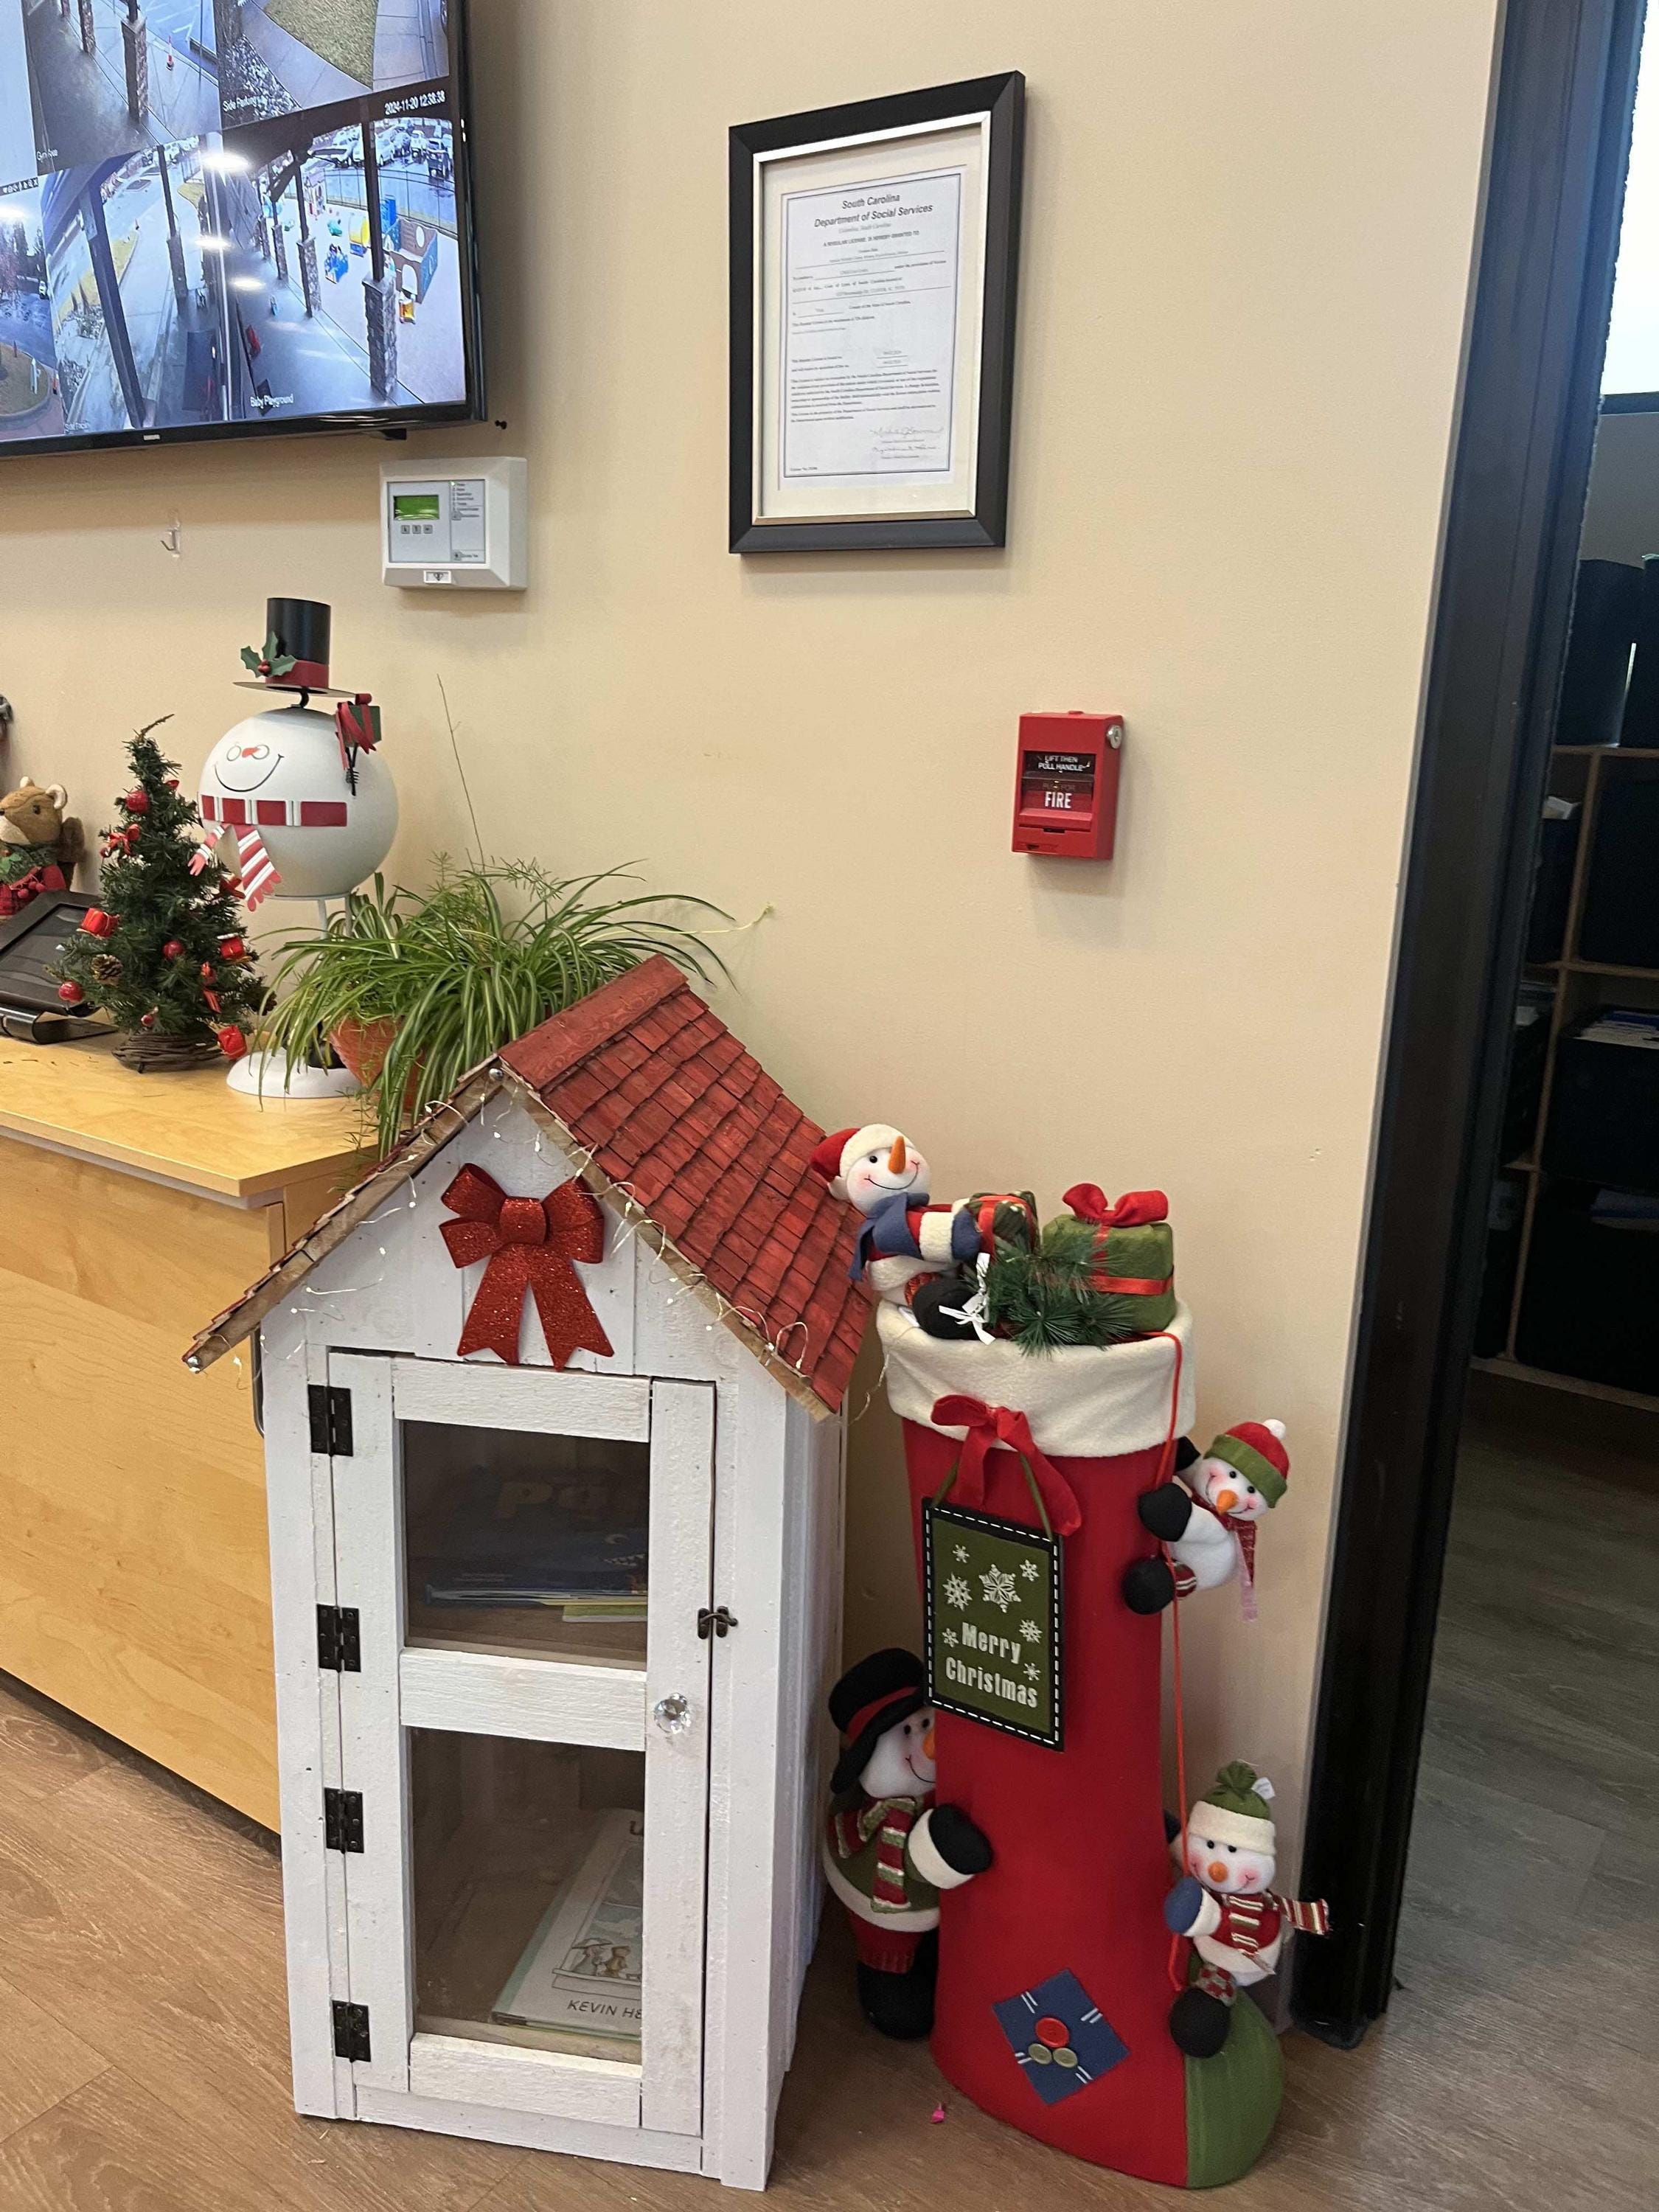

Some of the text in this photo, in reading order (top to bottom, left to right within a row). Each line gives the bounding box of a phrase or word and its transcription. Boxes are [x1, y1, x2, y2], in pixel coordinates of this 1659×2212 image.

[842, 194, 900, 209] South Carolina
[814, 204, 933, 228] Department of Social Services
[1037, 762, 1084, 772] PULL HANDLE
[1044, 791, 1072, 809] FIRE
[961, 1622, 1022, 1665] Merry
[945, 1657, 1038, 1708] Christmas
[567, 2000, 618, 2016] KEVIN
